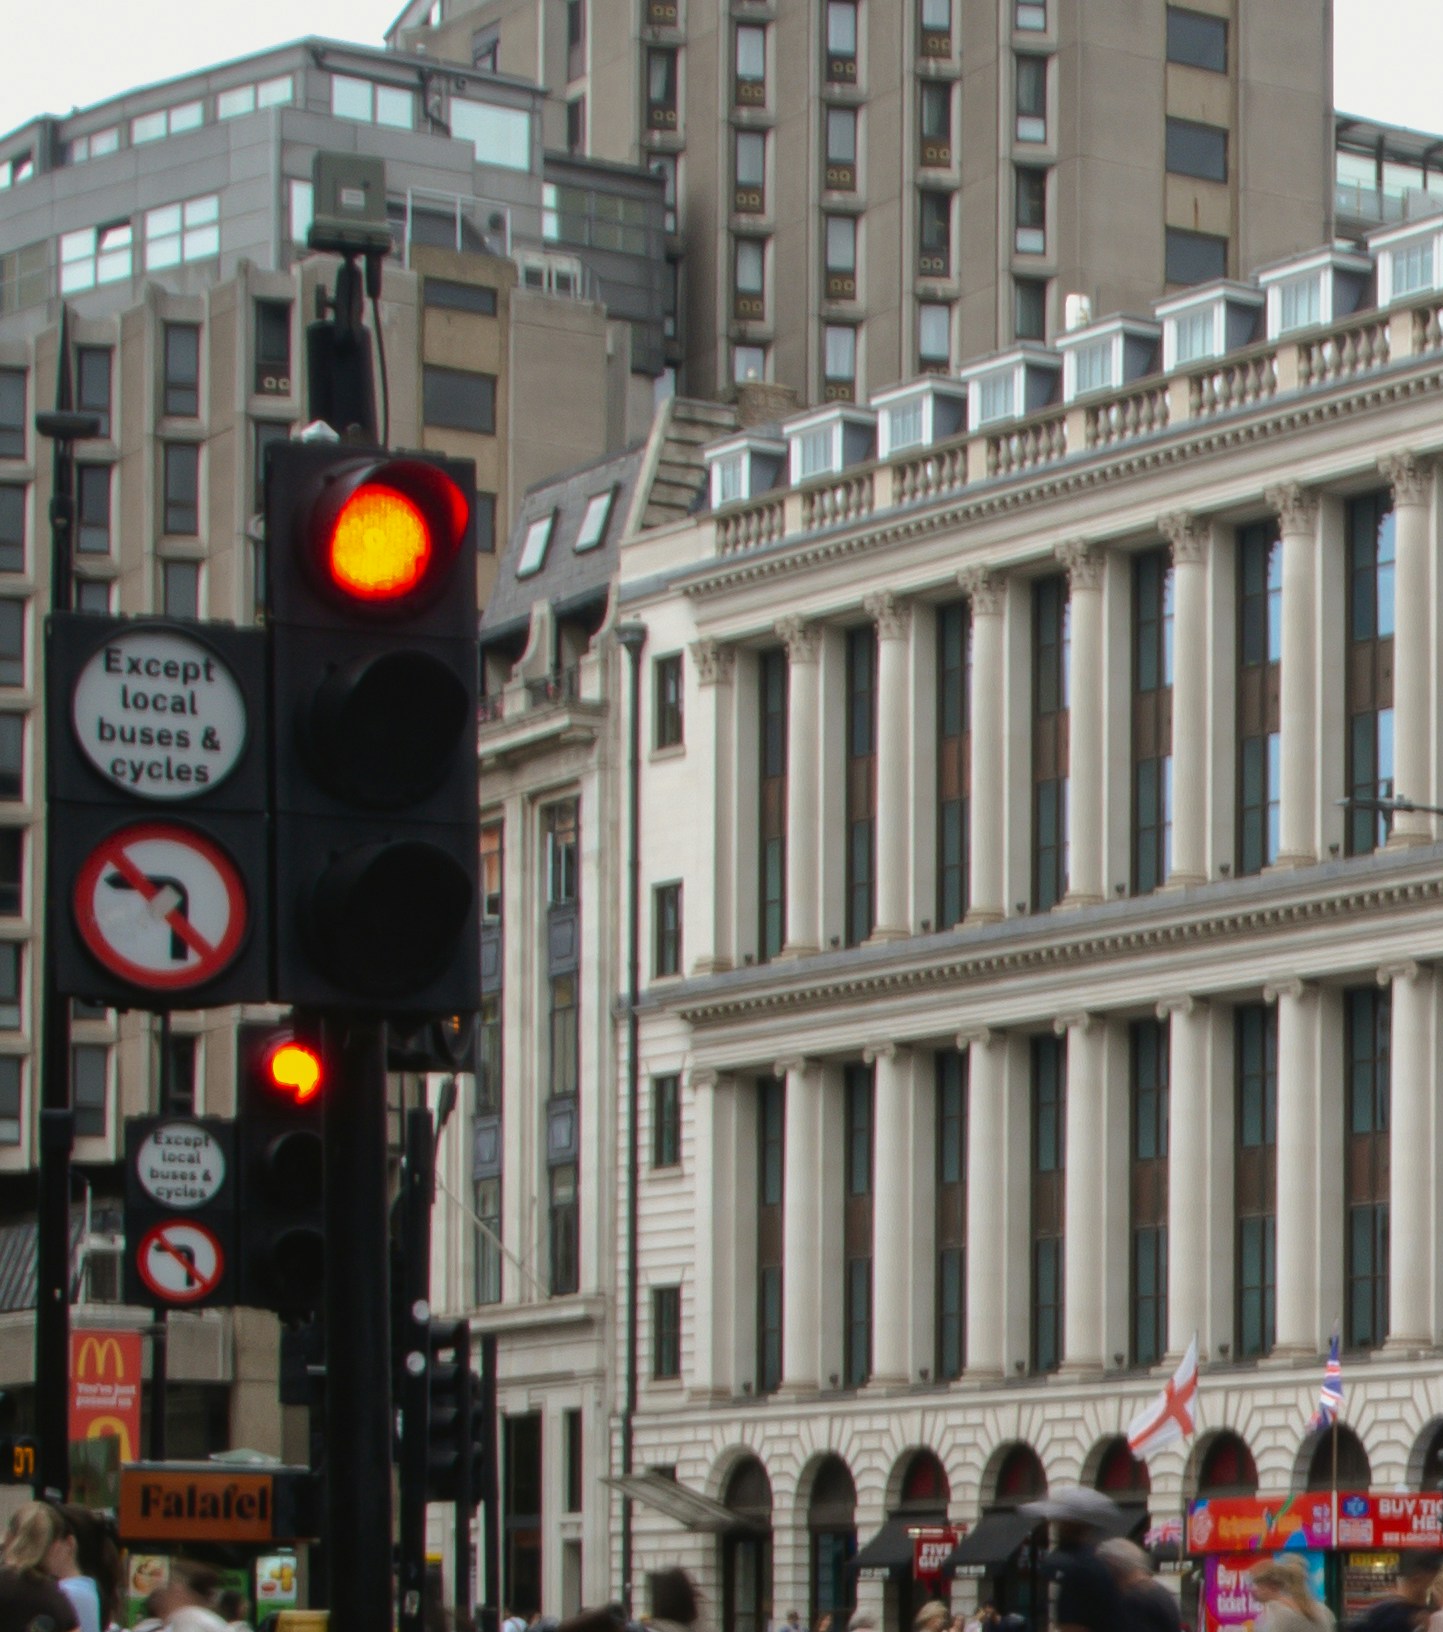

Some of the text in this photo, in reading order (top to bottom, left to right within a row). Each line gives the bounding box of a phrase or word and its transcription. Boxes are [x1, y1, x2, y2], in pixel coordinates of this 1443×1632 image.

[103, 647, 215, 685] Except
[120, 684, 198, 715] local
[97, 716, 221, 752] buses &
[110, 755, 210, 784] cycles
[152, 1130, 211, 1148] Except
[161, 1149, 201, 1164] local
[149, 1167, 212, 1182] buses &
[155, 1184, 207, 1199] cycles
[141, 1483, 269, 1520] Falafel
[1379, 1498, 1417, 1516] BUY
[922, 1542, 953, 1557] FIVE
